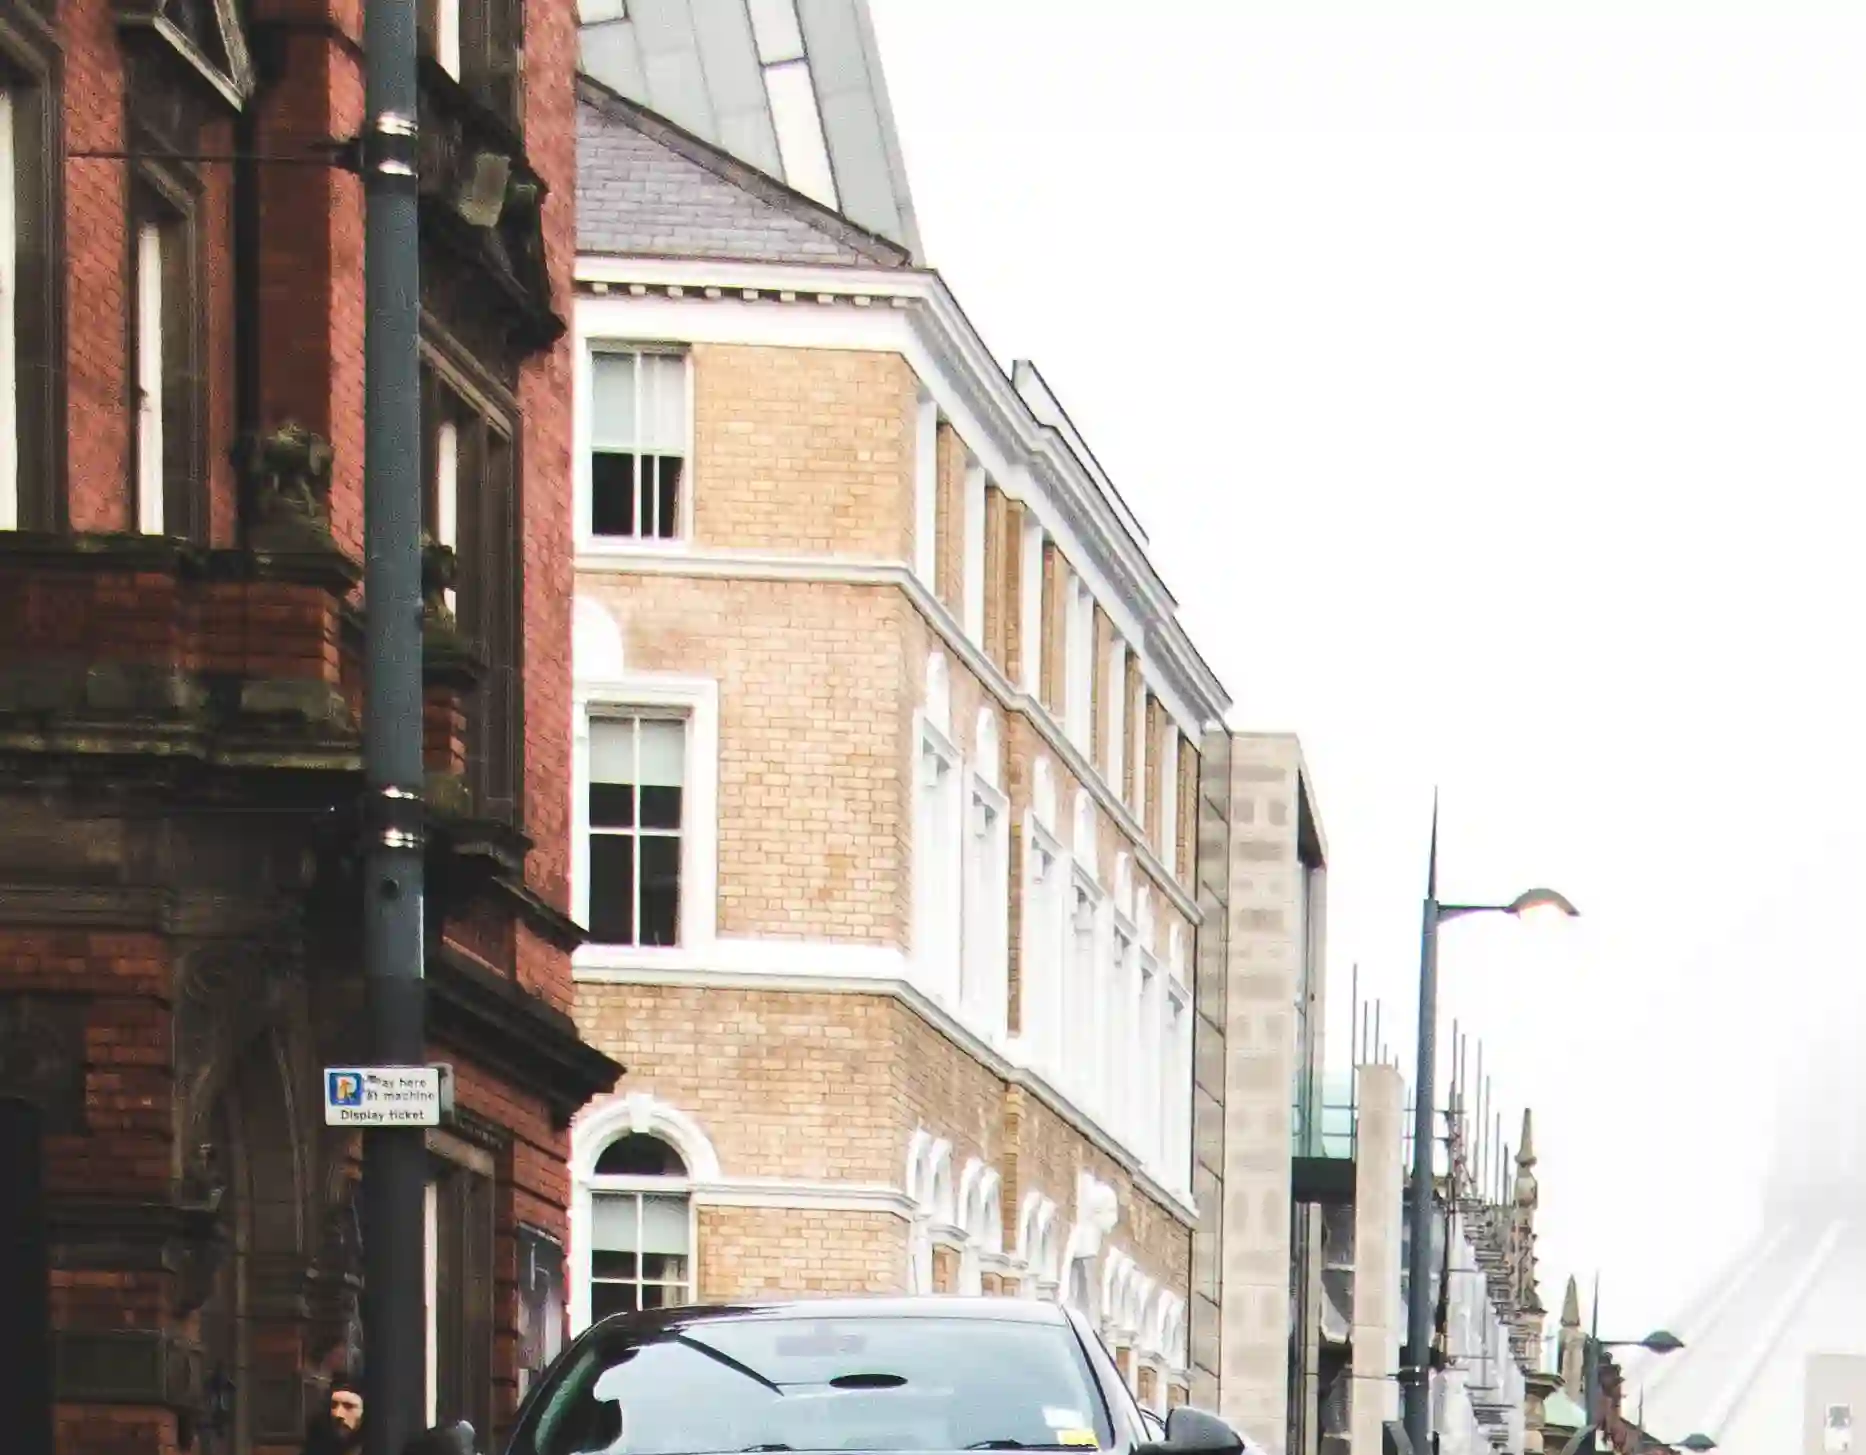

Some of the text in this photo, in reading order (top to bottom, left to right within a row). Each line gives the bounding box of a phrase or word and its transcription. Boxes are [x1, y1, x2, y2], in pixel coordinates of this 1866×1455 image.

[383, 1091, 434, 1102] machine
[341, 1109, 425, 1122] Display ticket
